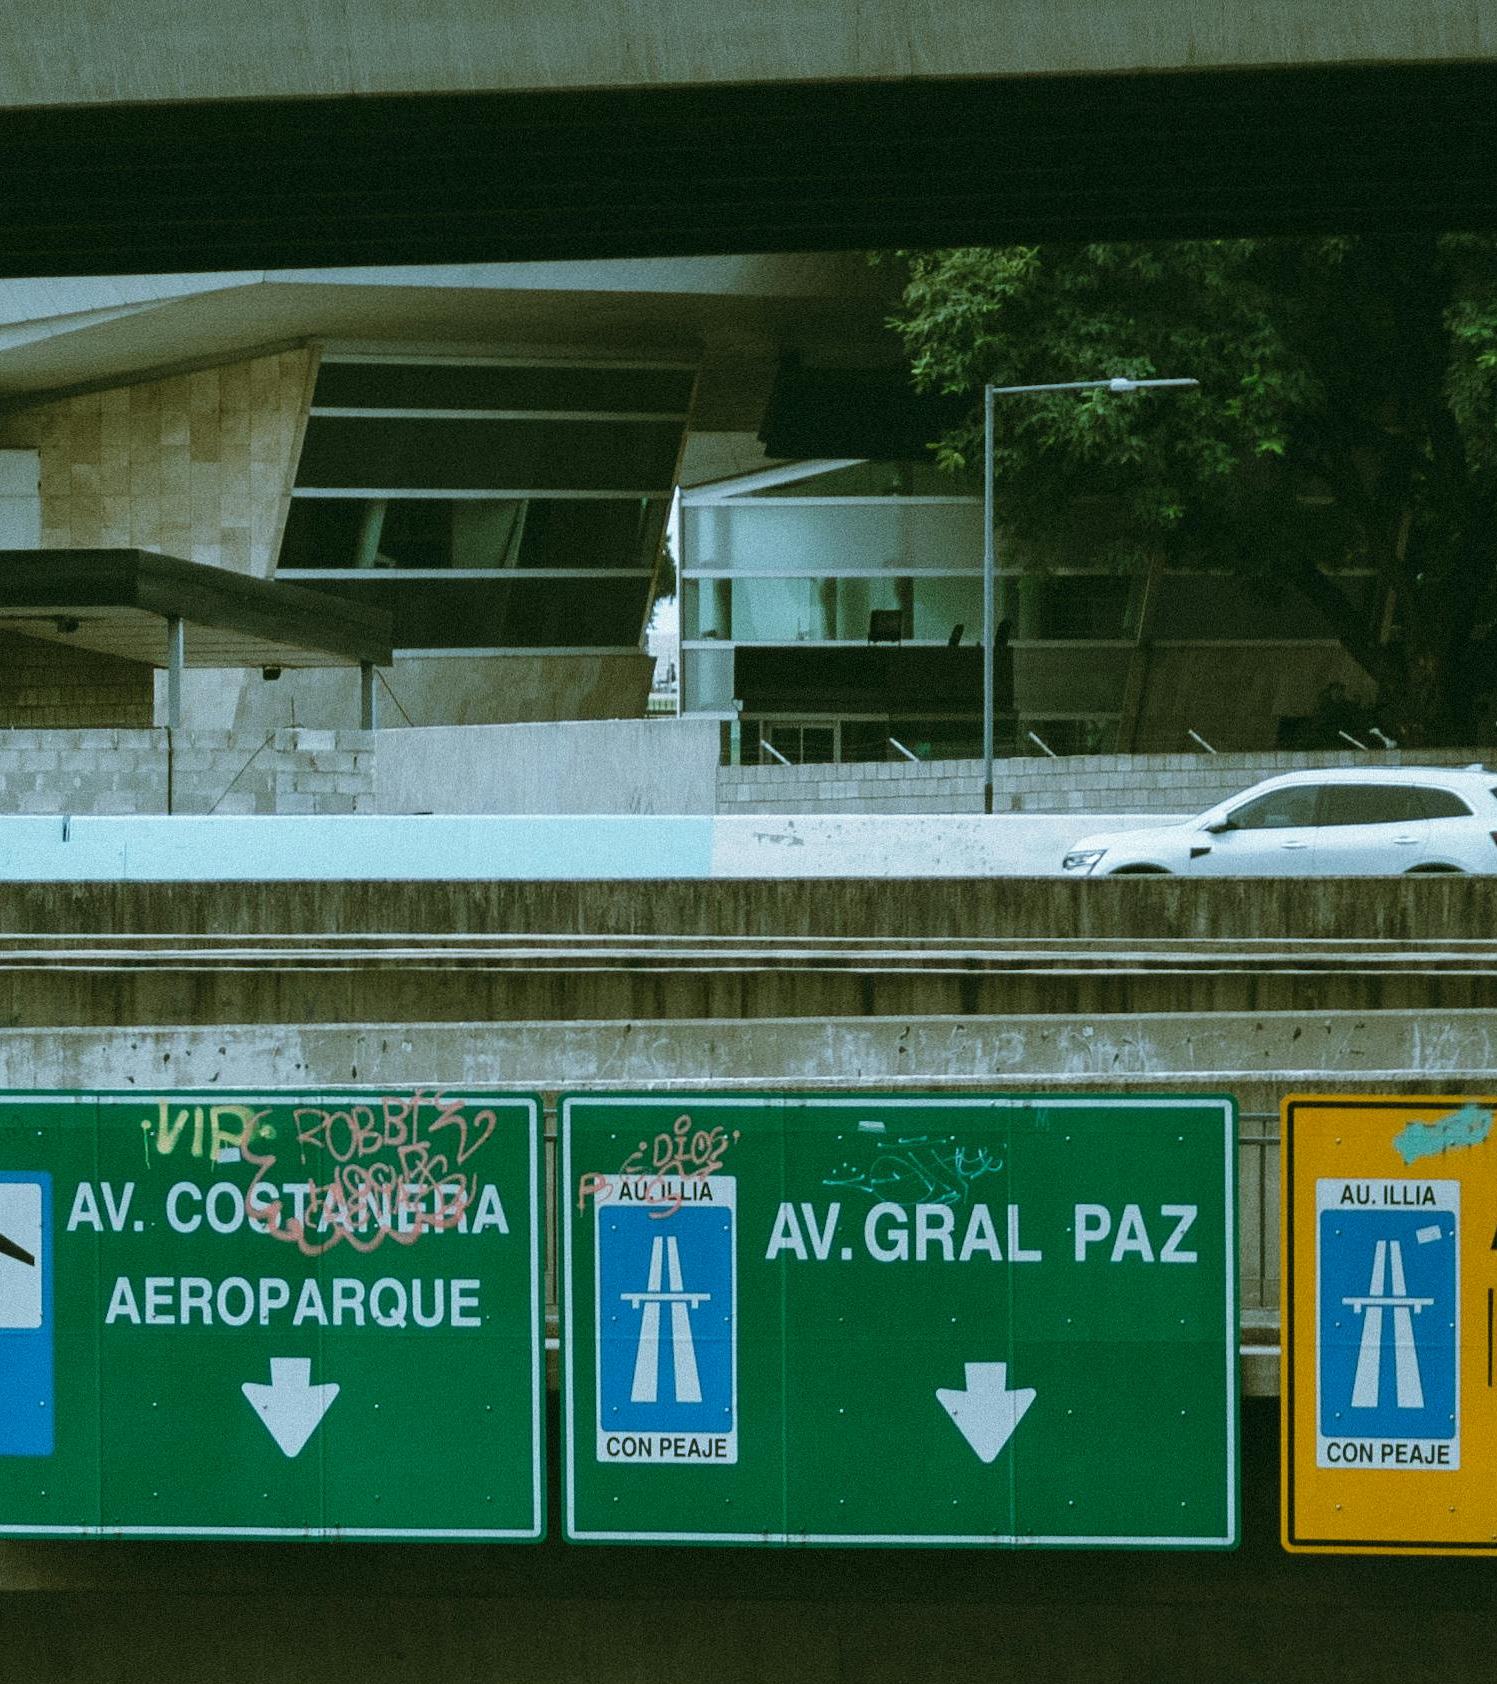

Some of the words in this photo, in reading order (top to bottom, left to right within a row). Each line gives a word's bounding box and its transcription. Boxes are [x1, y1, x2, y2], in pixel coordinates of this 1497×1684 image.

[661, 1182, 713, 1201] ILLIA
[1340, 1185, 1377, 1206] AU.
[1382, 1186, 1437, 1206] ILLIA
[66, 1181, 144, 1232] AV.
[165, 1181, 510, 1235] COSTANERA
[1073, 1203, 1198, 1263] PAZ
[104, 1275, 482, 1330] AEROPARQUE
[606, 1436, 652, 1458] CON
[658, 1437, 727, 1459] PEAJE
[1326, 1442, 1374, 1464] CON
[1380, 1443, 1451, 1466] PEAJE
